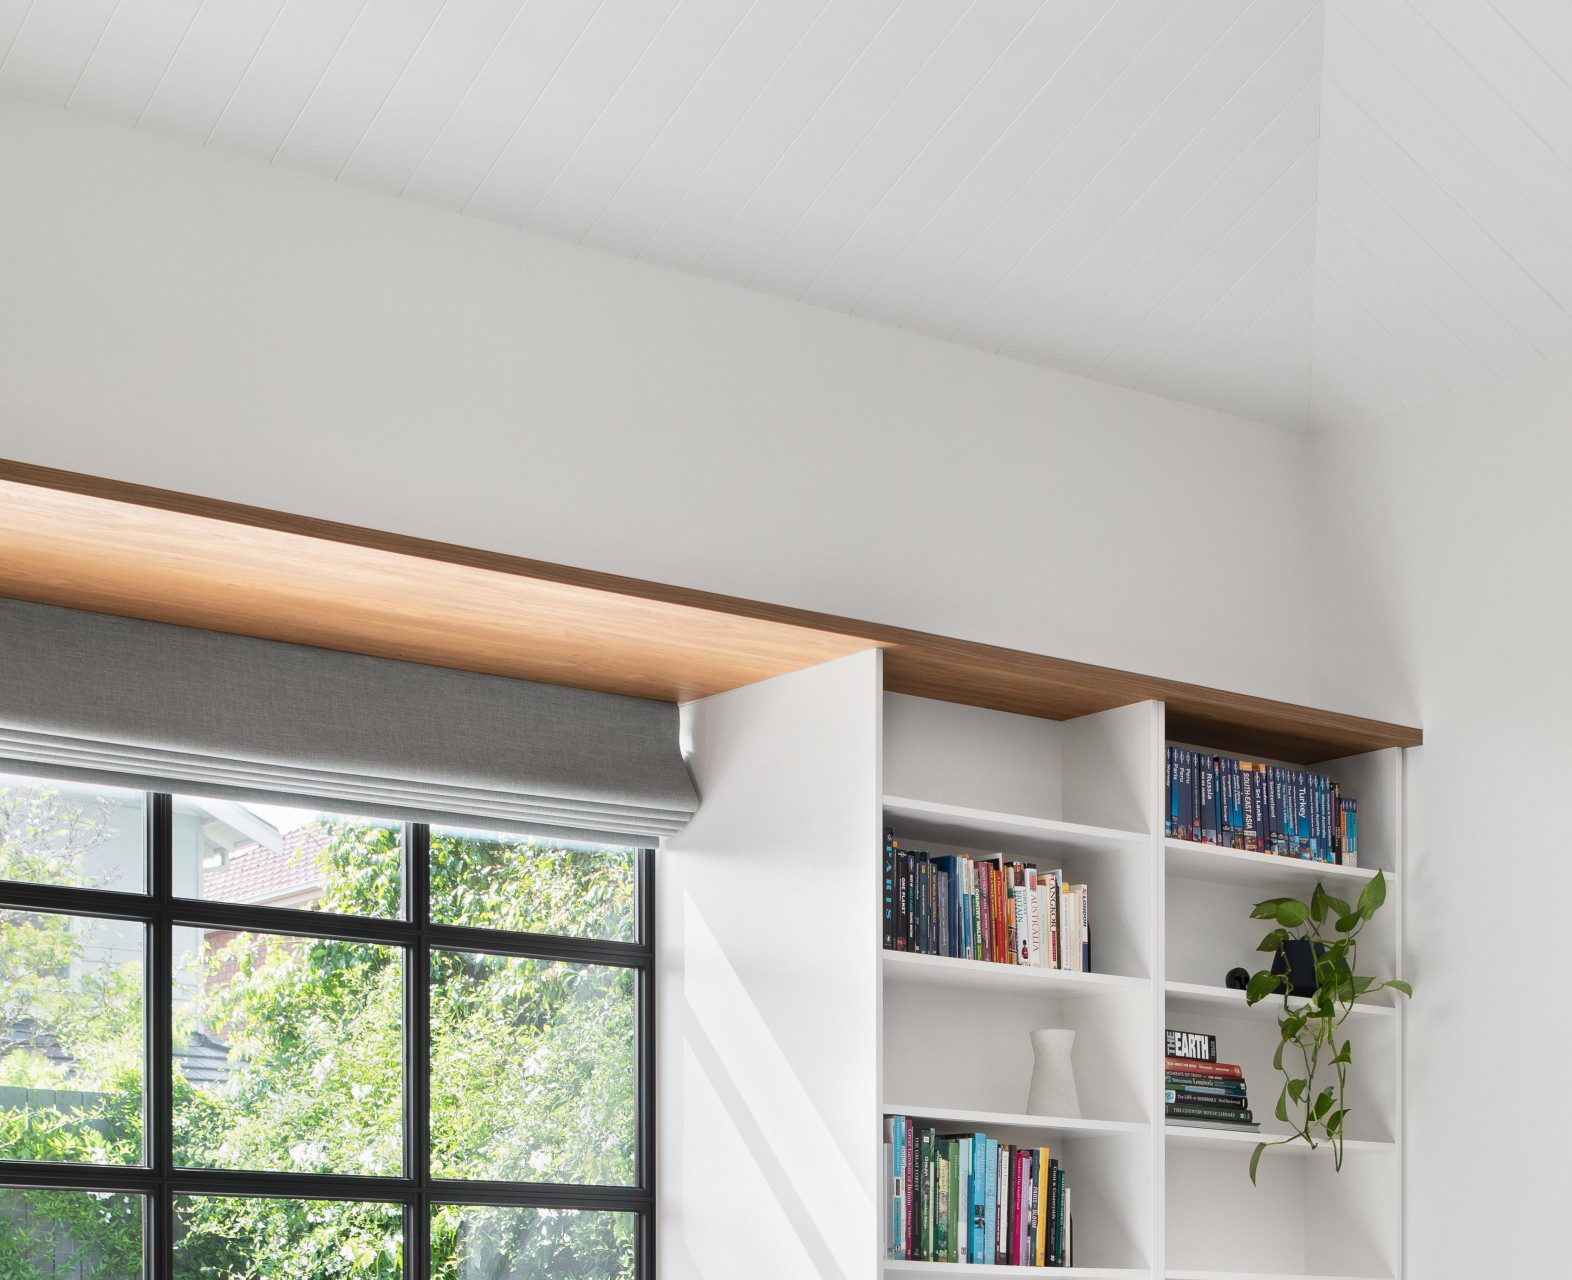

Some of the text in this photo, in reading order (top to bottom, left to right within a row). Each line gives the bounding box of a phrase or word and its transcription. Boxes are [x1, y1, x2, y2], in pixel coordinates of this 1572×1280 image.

[1298, 787, 1306, 818] Turkey
[1245, 814, 1253, 829] ASIA
[1016, 890, 1024, 923] BRITAIN
[1030, 894, 1039, 952] AUSTRALIA
[1166, 1031, 1175, 1055] THE
[1175, 1032, 1209, 1060] EARTH
